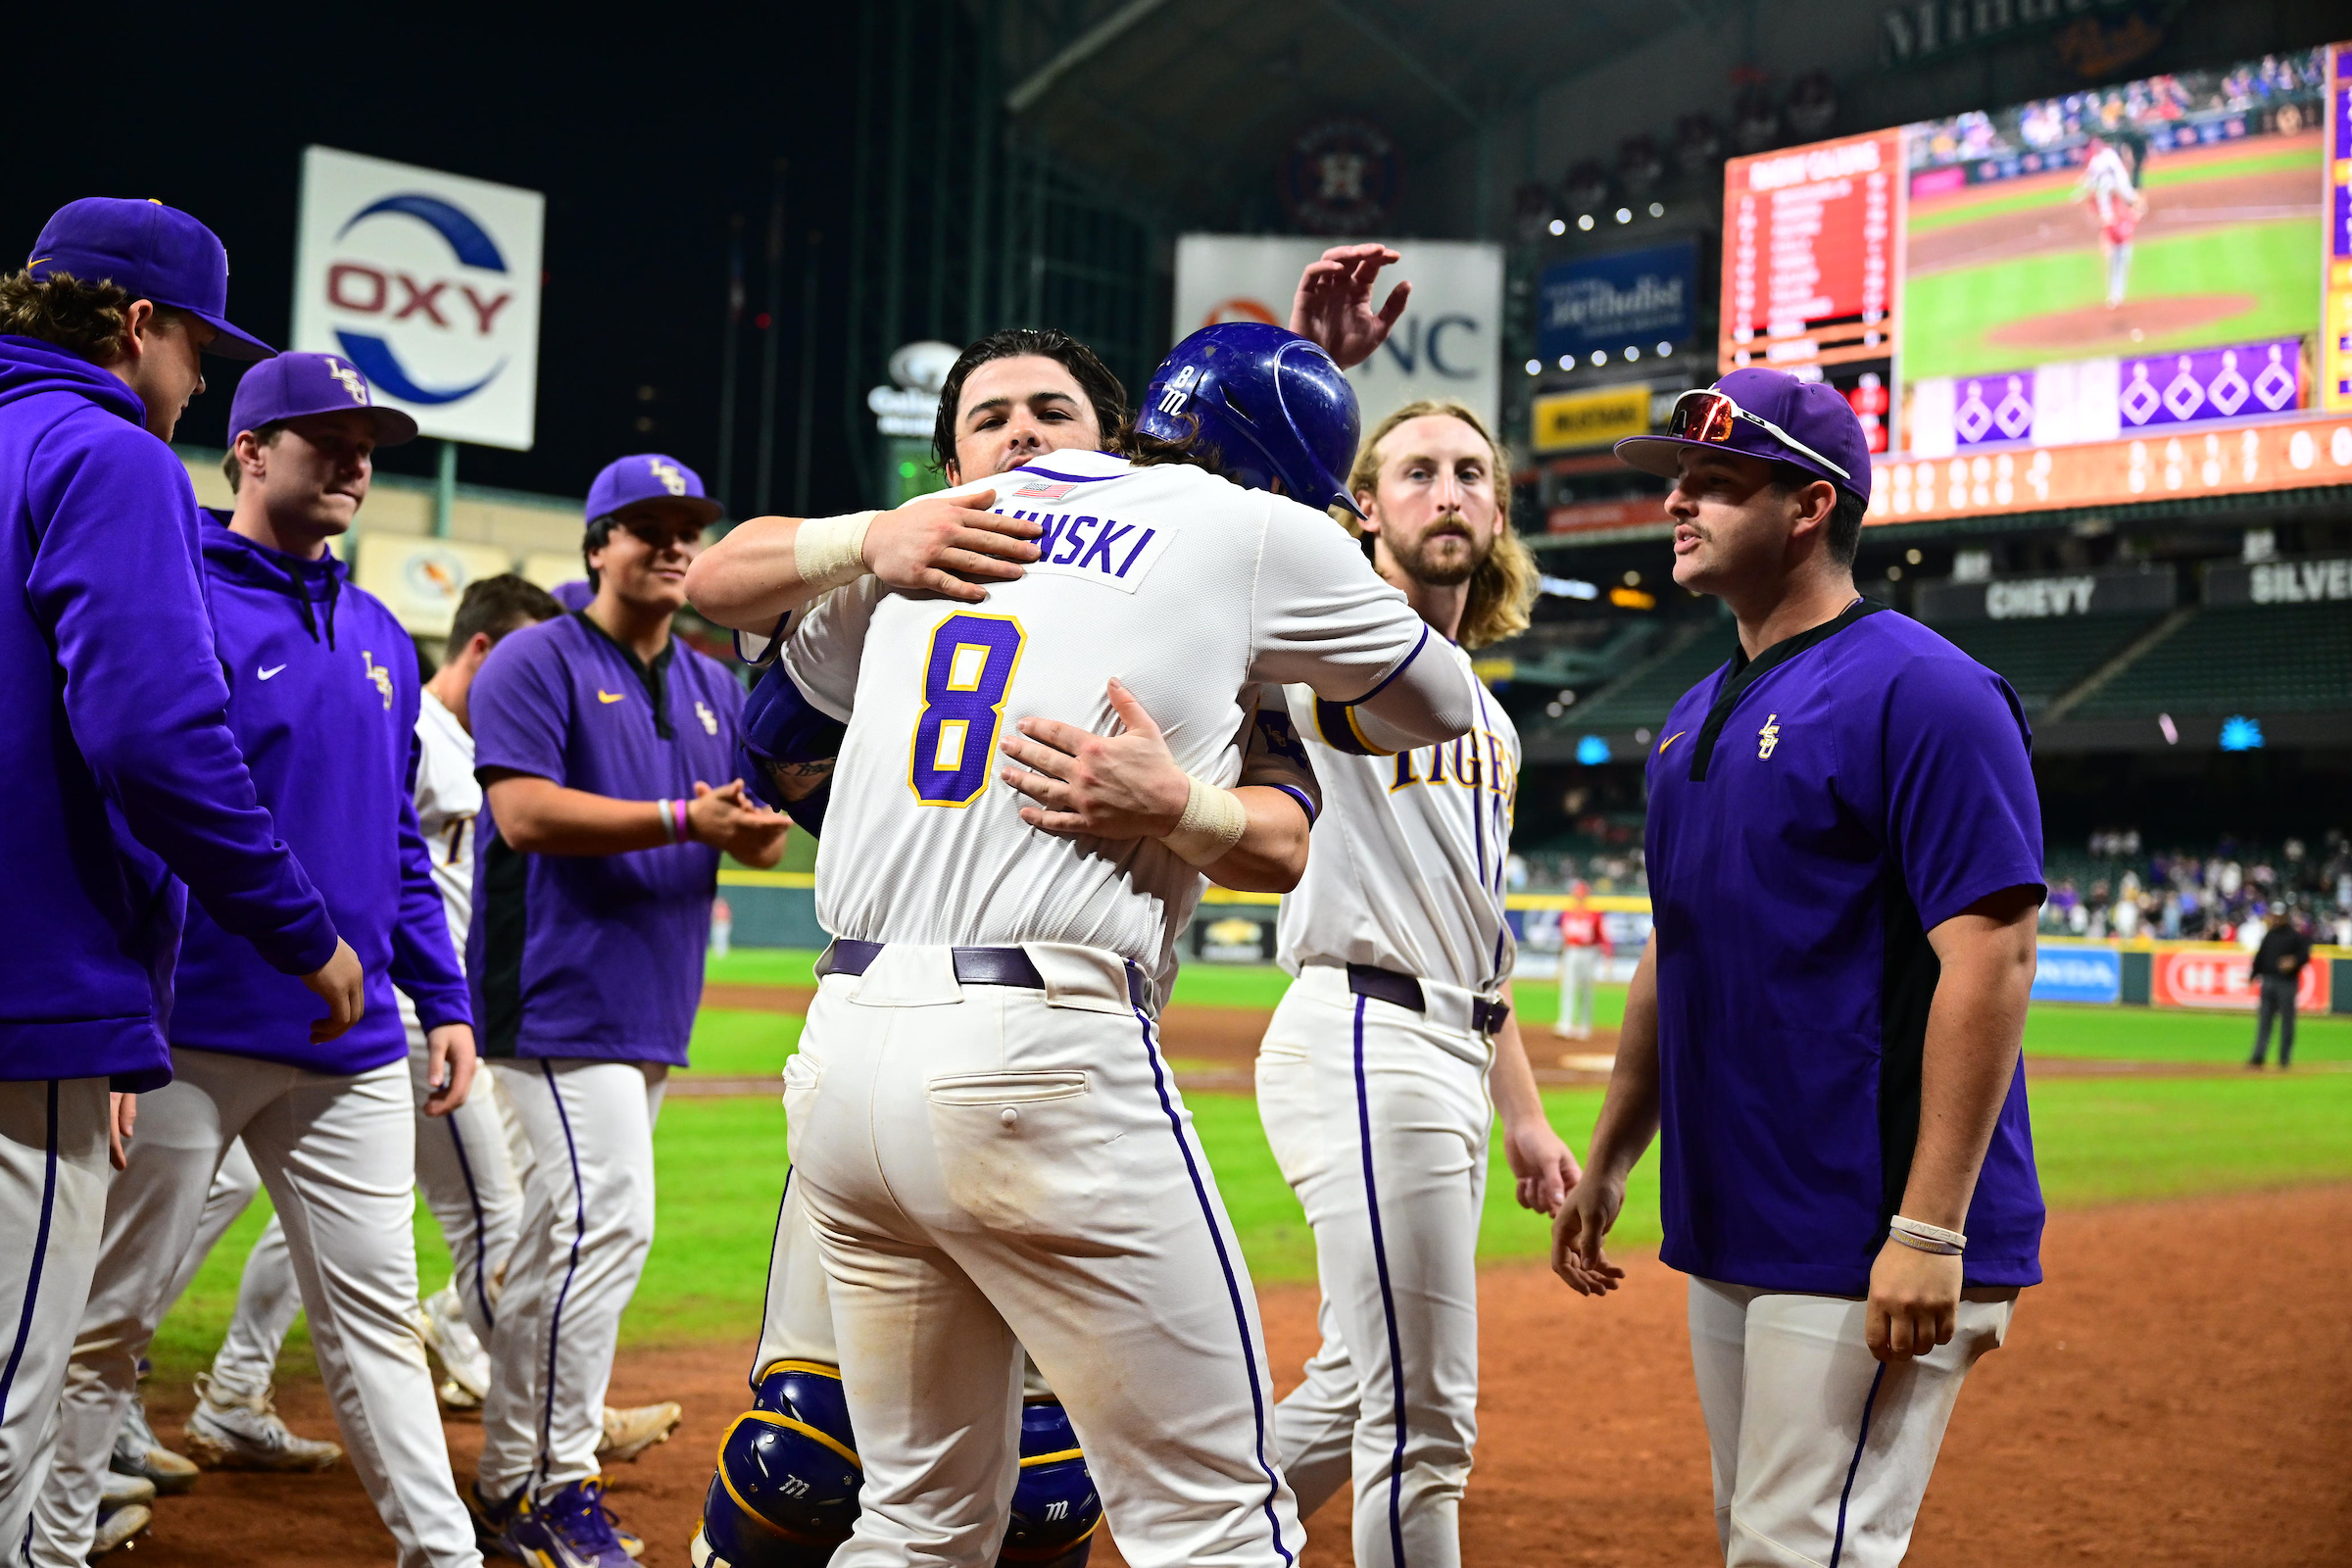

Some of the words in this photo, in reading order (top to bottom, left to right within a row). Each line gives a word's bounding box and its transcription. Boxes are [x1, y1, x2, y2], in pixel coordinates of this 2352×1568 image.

[327, 263, 513, 335] OXY
[1173, 365, 1195, 389] 8
[1360, 313, 1480, 380] NC
[995, 509, 1155, 578] NSKI
[1985, 576, 2096, 619] CHEVY
[907, 610, 1028, 808] 8
[1758, 713, 1781, 760] LSU
